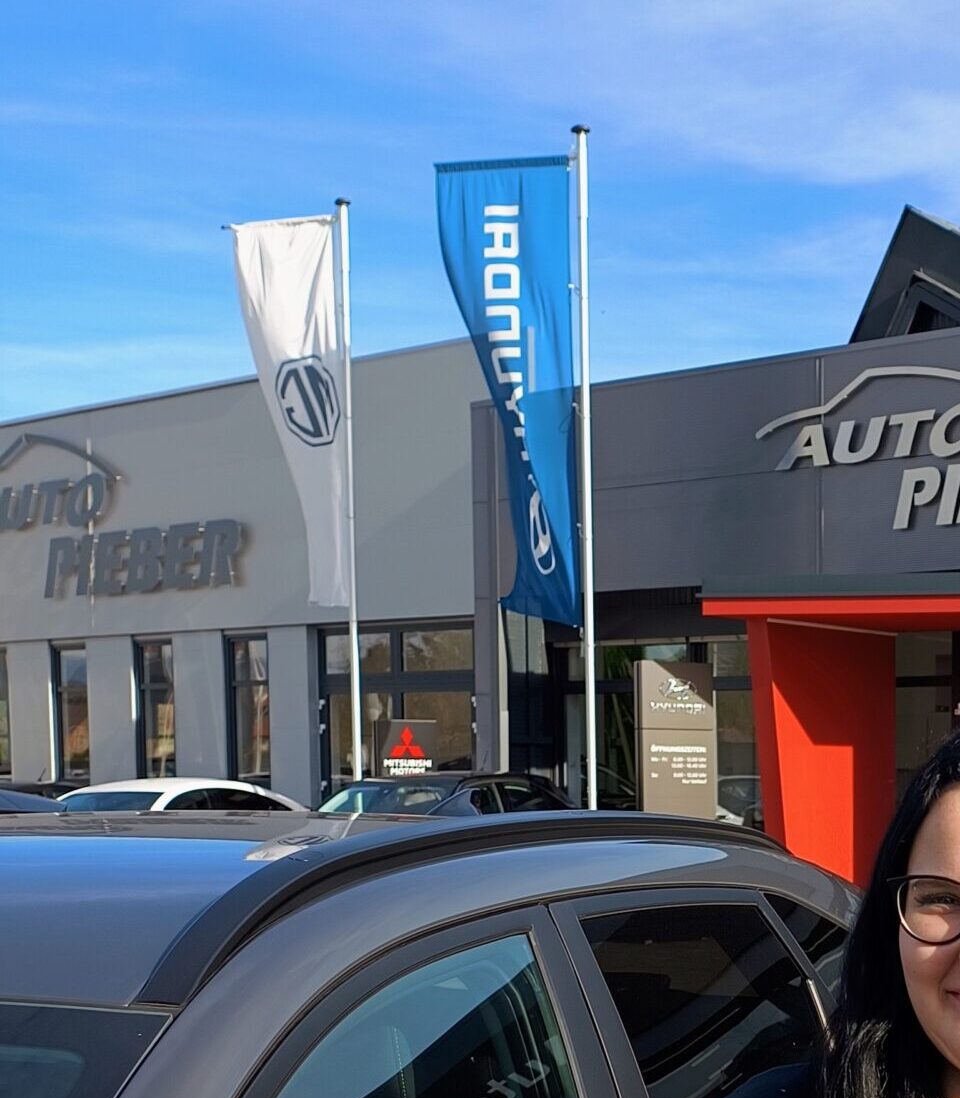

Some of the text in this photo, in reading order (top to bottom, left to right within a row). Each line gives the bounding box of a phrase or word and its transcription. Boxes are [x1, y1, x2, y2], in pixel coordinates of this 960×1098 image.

[0, 472, 107, 530] UTO
[44, 518, 242, 599] PIEBER
[383, 758, 433, 768] MITSUBISHI
